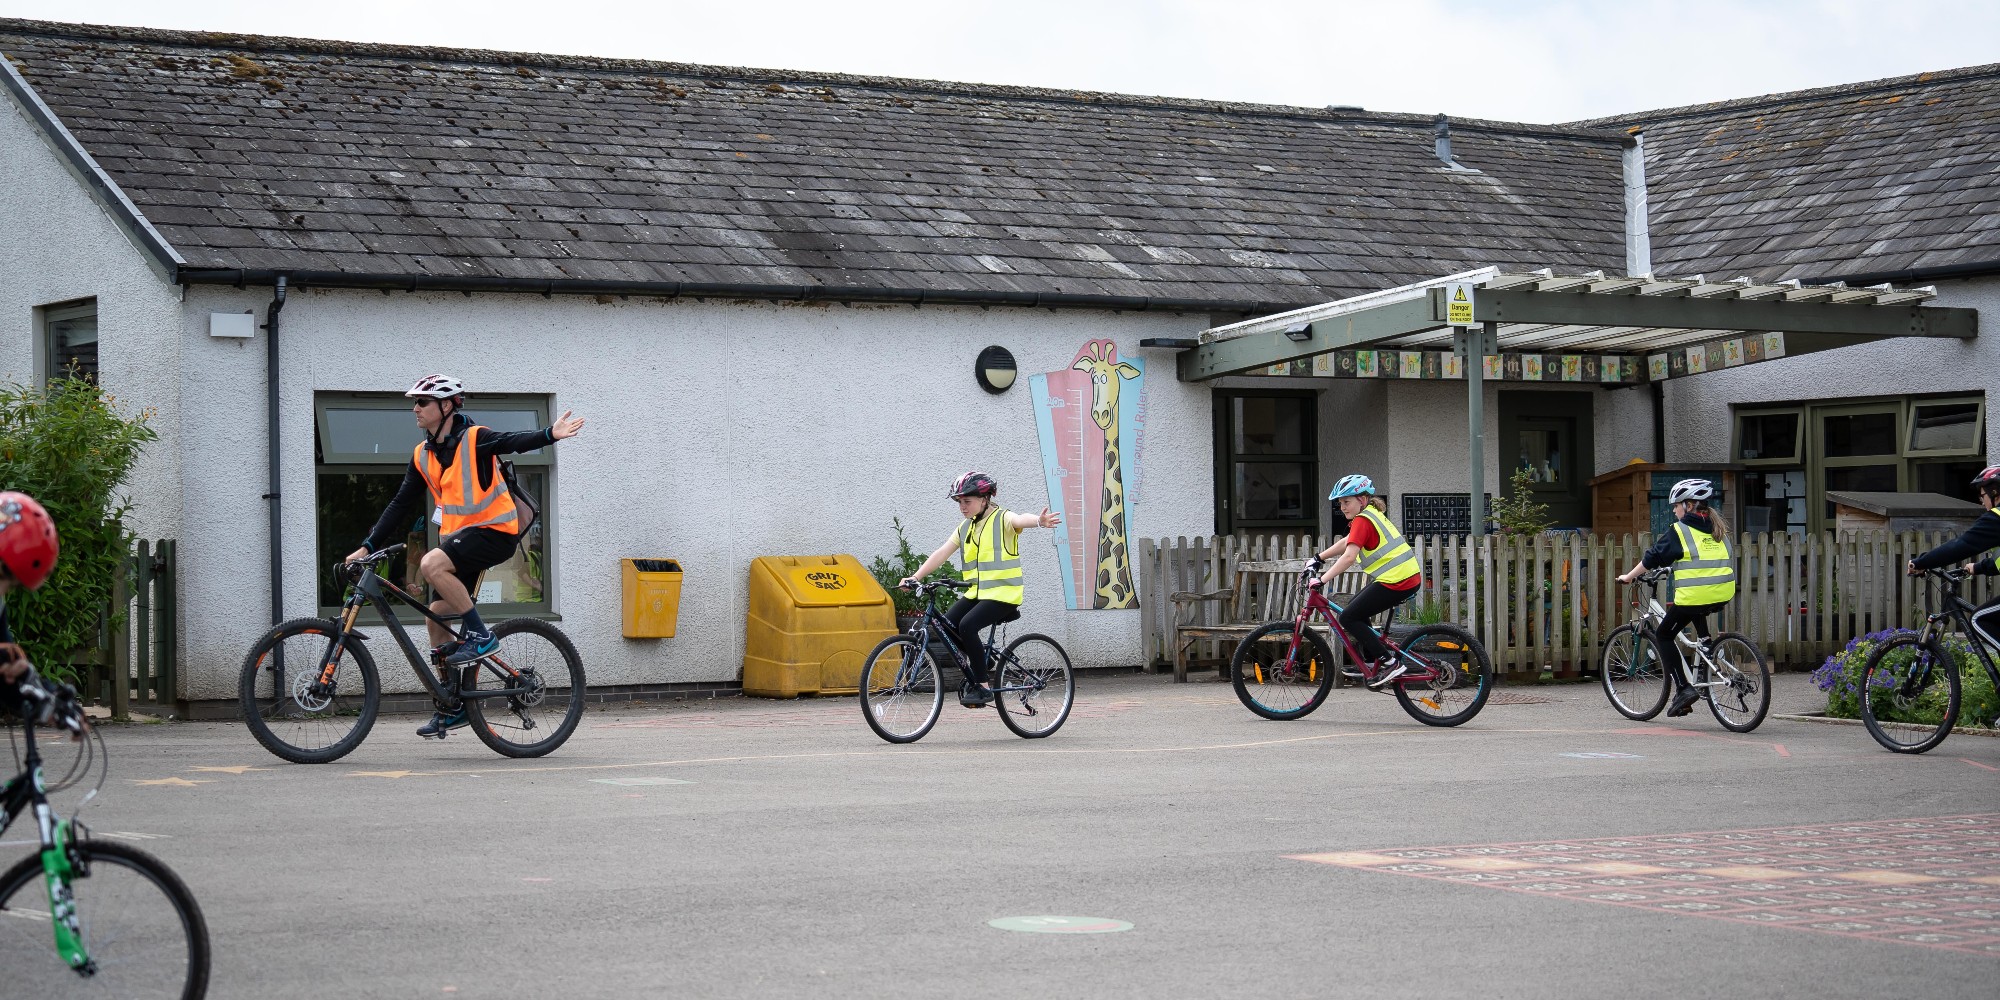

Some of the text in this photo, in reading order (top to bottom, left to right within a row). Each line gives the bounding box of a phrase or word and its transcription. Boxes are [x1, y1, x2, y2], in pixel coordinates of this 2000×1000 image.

[1128, 388, 1147, 503] Playground Ruler
[1050, 467, 1068, 477] 1.5m
[807, 572, 840, 581] GRIT
[814, 580, 844, 591] SALT
